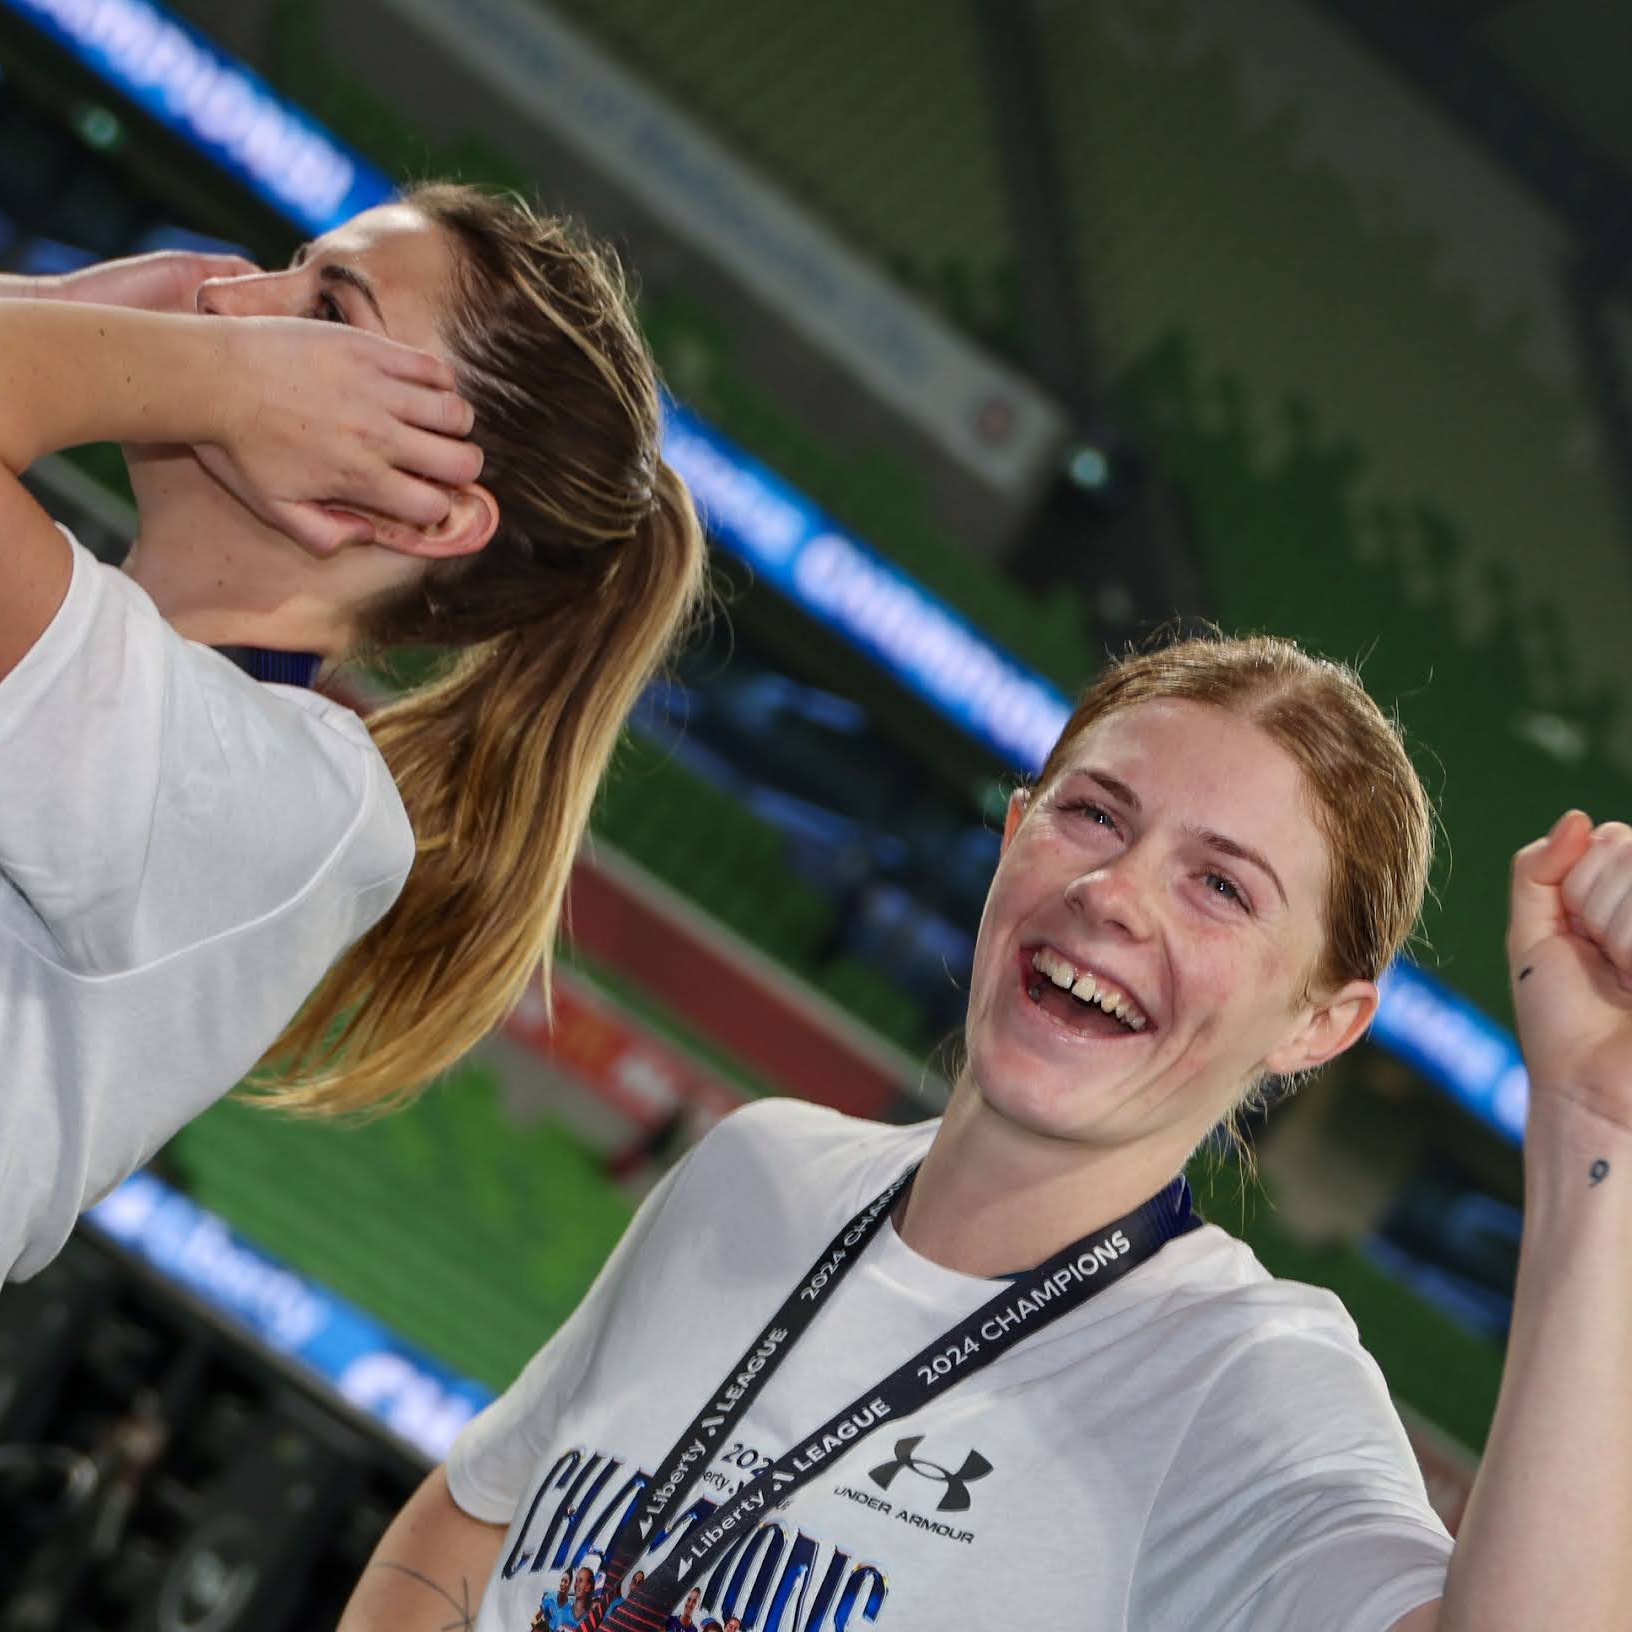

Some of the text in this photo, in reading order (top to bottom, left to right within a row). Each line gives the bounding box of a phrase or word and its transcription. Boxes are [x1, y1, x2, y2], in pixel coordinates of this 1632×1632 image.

[647, 1439, 707, 1516] Liberty
[716, 1327, 789, 1413] LEAGUE
[800, 1249, 848, 1302] 2024
[689, 1228, 1133, 1561] Liberty LEAGUE 2024 CHAMPIONS
[720, 1442, 775, 1479] 202
[833, 1485, 893, 1515] UNDER
[895, 1509, 976, 1545] ARMOUR
